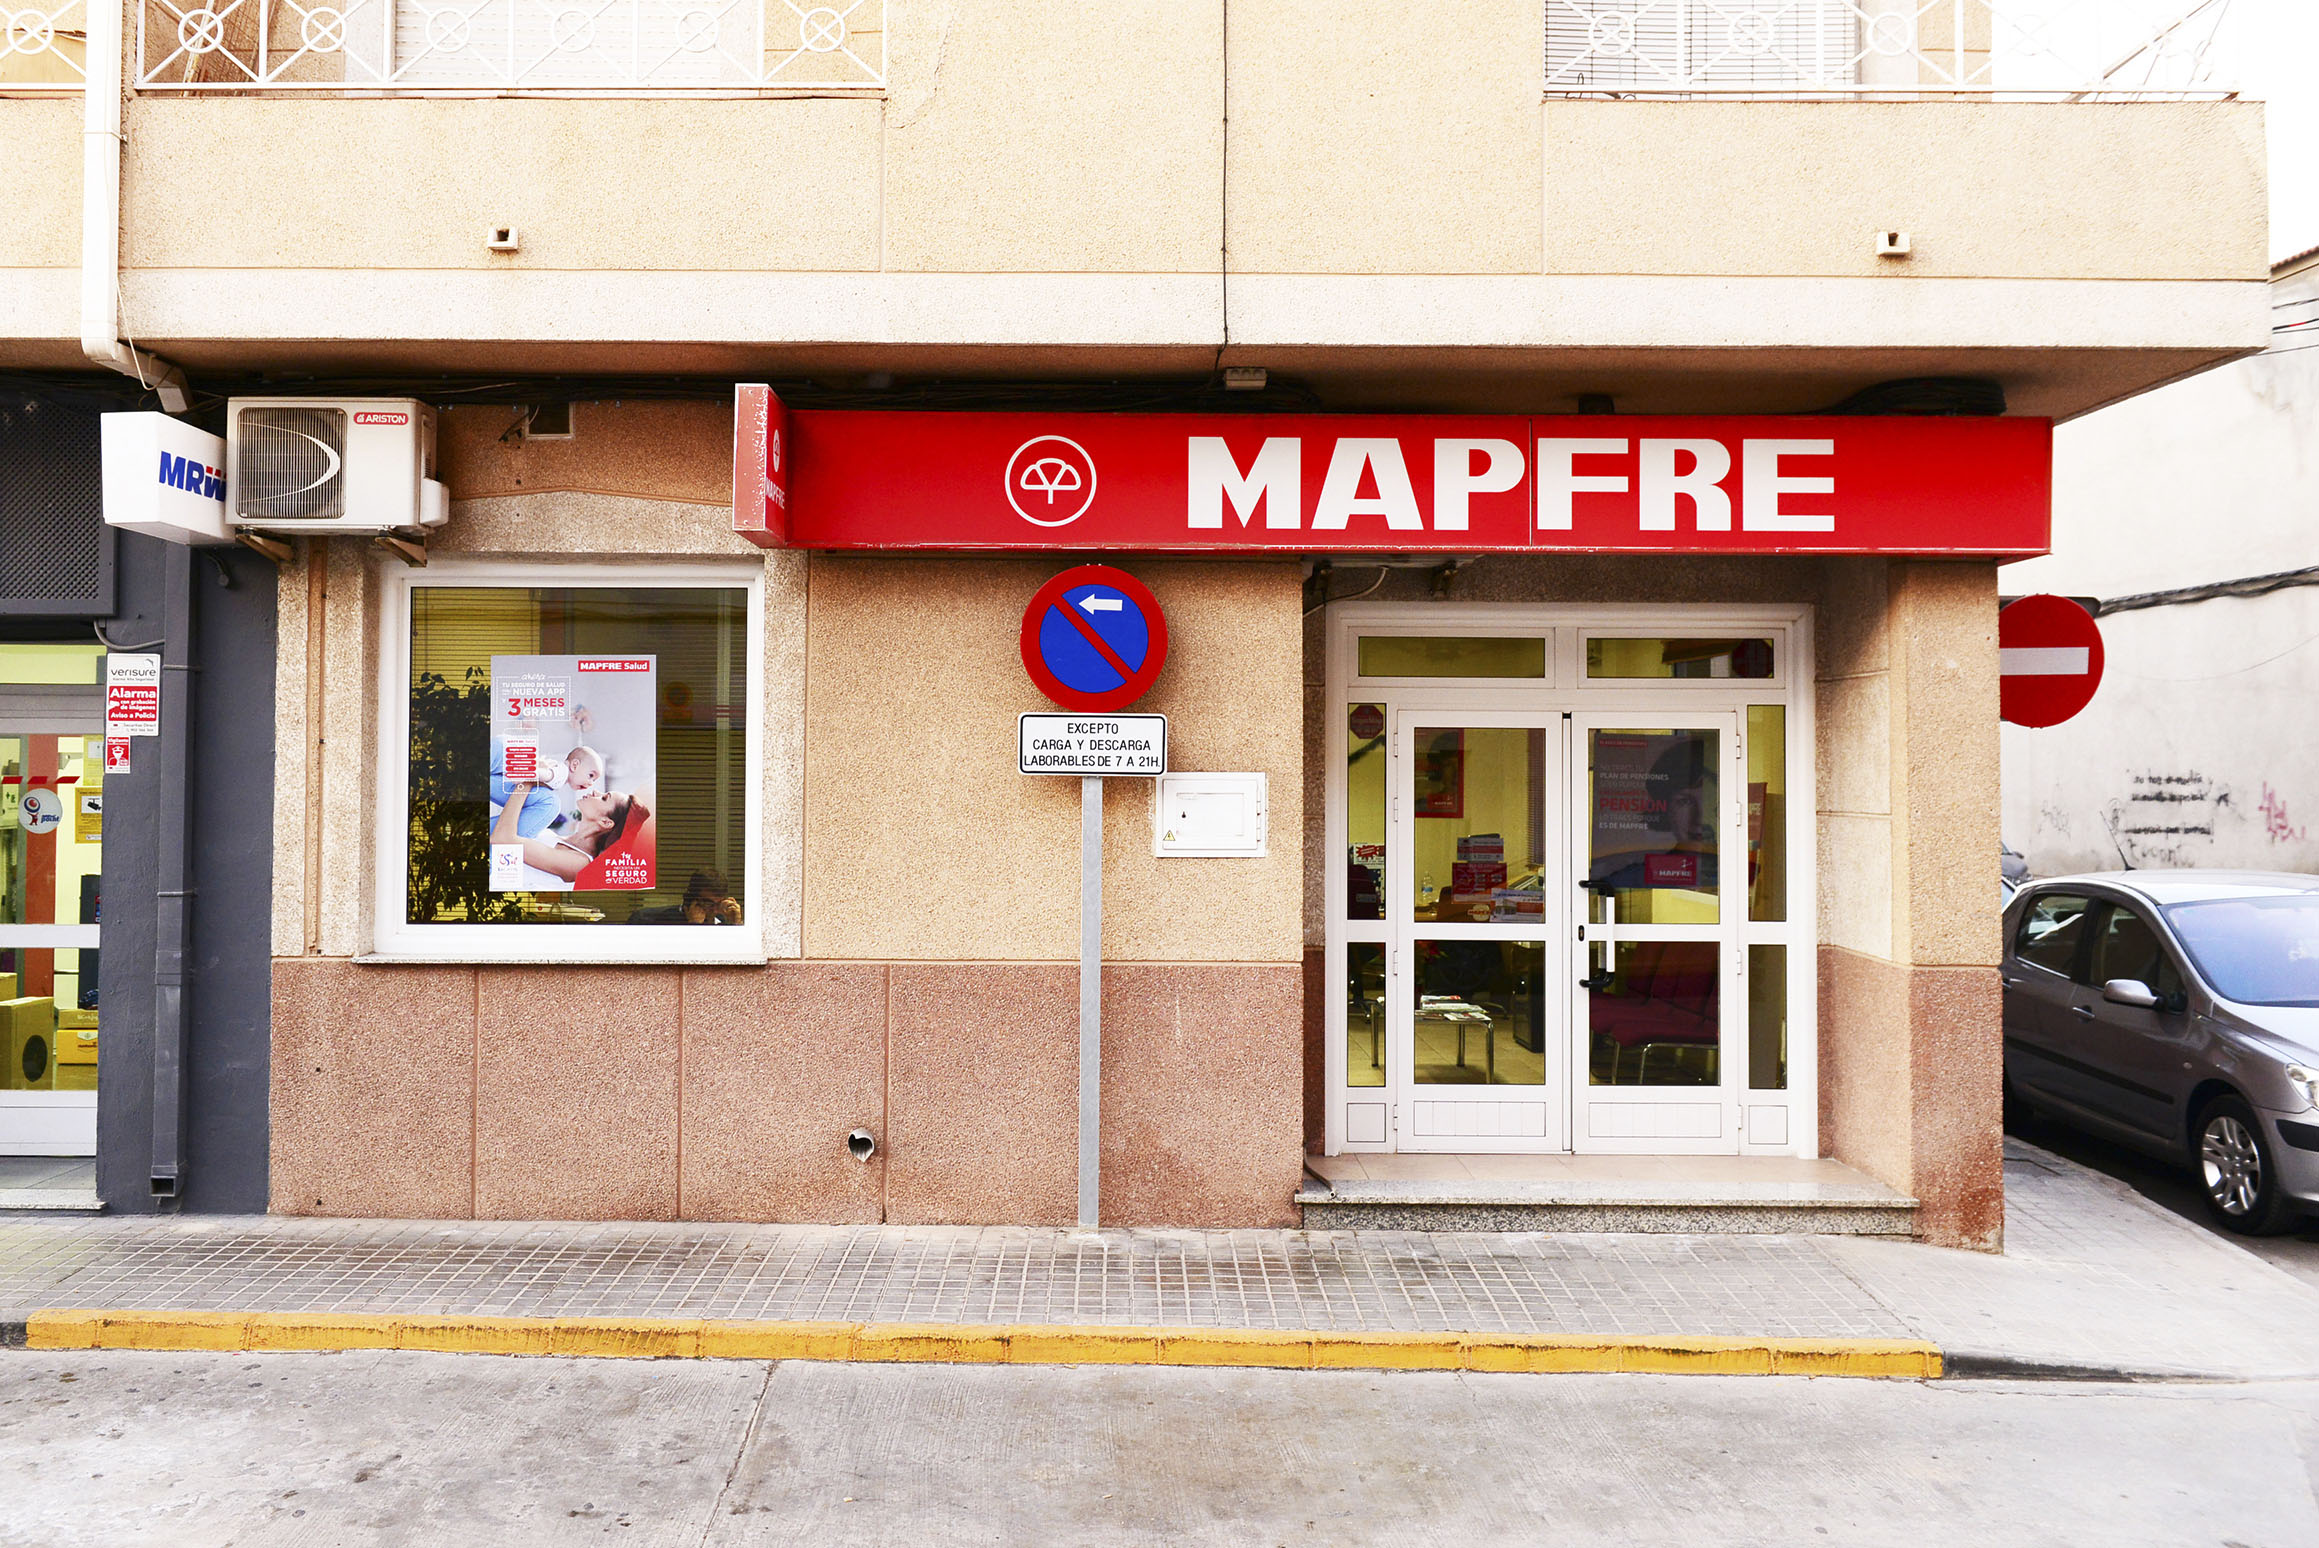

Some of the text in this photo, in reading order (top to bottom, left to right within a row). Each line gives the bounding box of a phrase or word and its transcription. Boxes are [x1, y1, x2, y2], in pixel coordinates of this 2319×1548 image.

[365, 414, 406, 424] ARISTON
[1187, 436, 1835, 532] MAPFRE
[580, 662, 648, 670] MAPFRE Salud
[110, 668, 157, 677] verisure
[109, 687, 156, 699] Alarma
[512, 688, 545, 696] NUEVA
[547, 688, 566, 696] APP
[507, 697, 521, 717] 3
[523, 697, 565, 708] MESES
[522, 707, 565, 717] GRATIS
[1067, 723, 1119, 734] EXCEPTO
[1032, 739, 1151, 751] CARGA Y DESCARGA
[1024, 755, 1161, 768] LABORABLES DE 7 A 21H.
[613, 876, 648, 884] VERDAD
